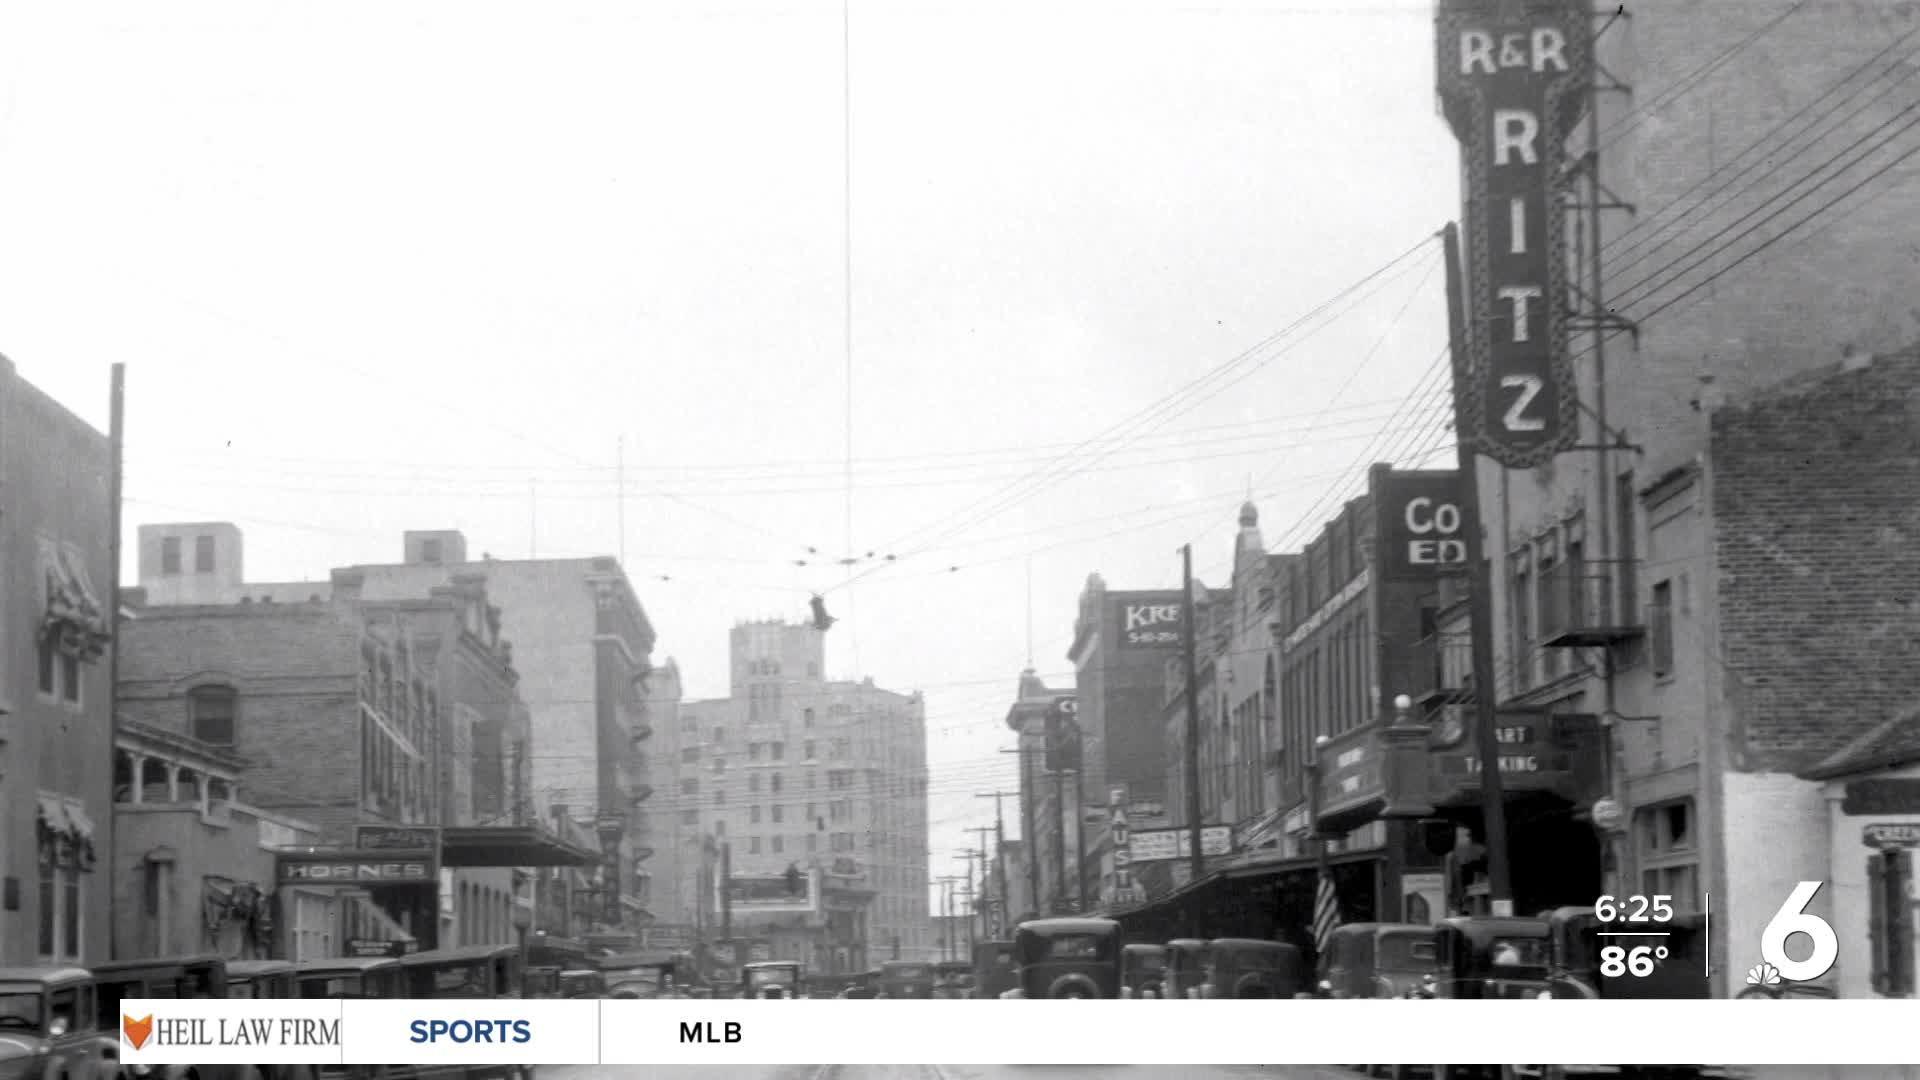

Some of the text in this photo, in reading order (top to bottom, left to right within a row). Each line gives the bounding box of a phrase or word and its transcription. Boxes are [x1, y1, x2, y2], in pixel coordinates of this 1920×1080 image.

[1460, 28, 1568, 75] R&R
[1494, 109, 1546, 431] RITZ
[1408, 540, 1467, 564] ED
